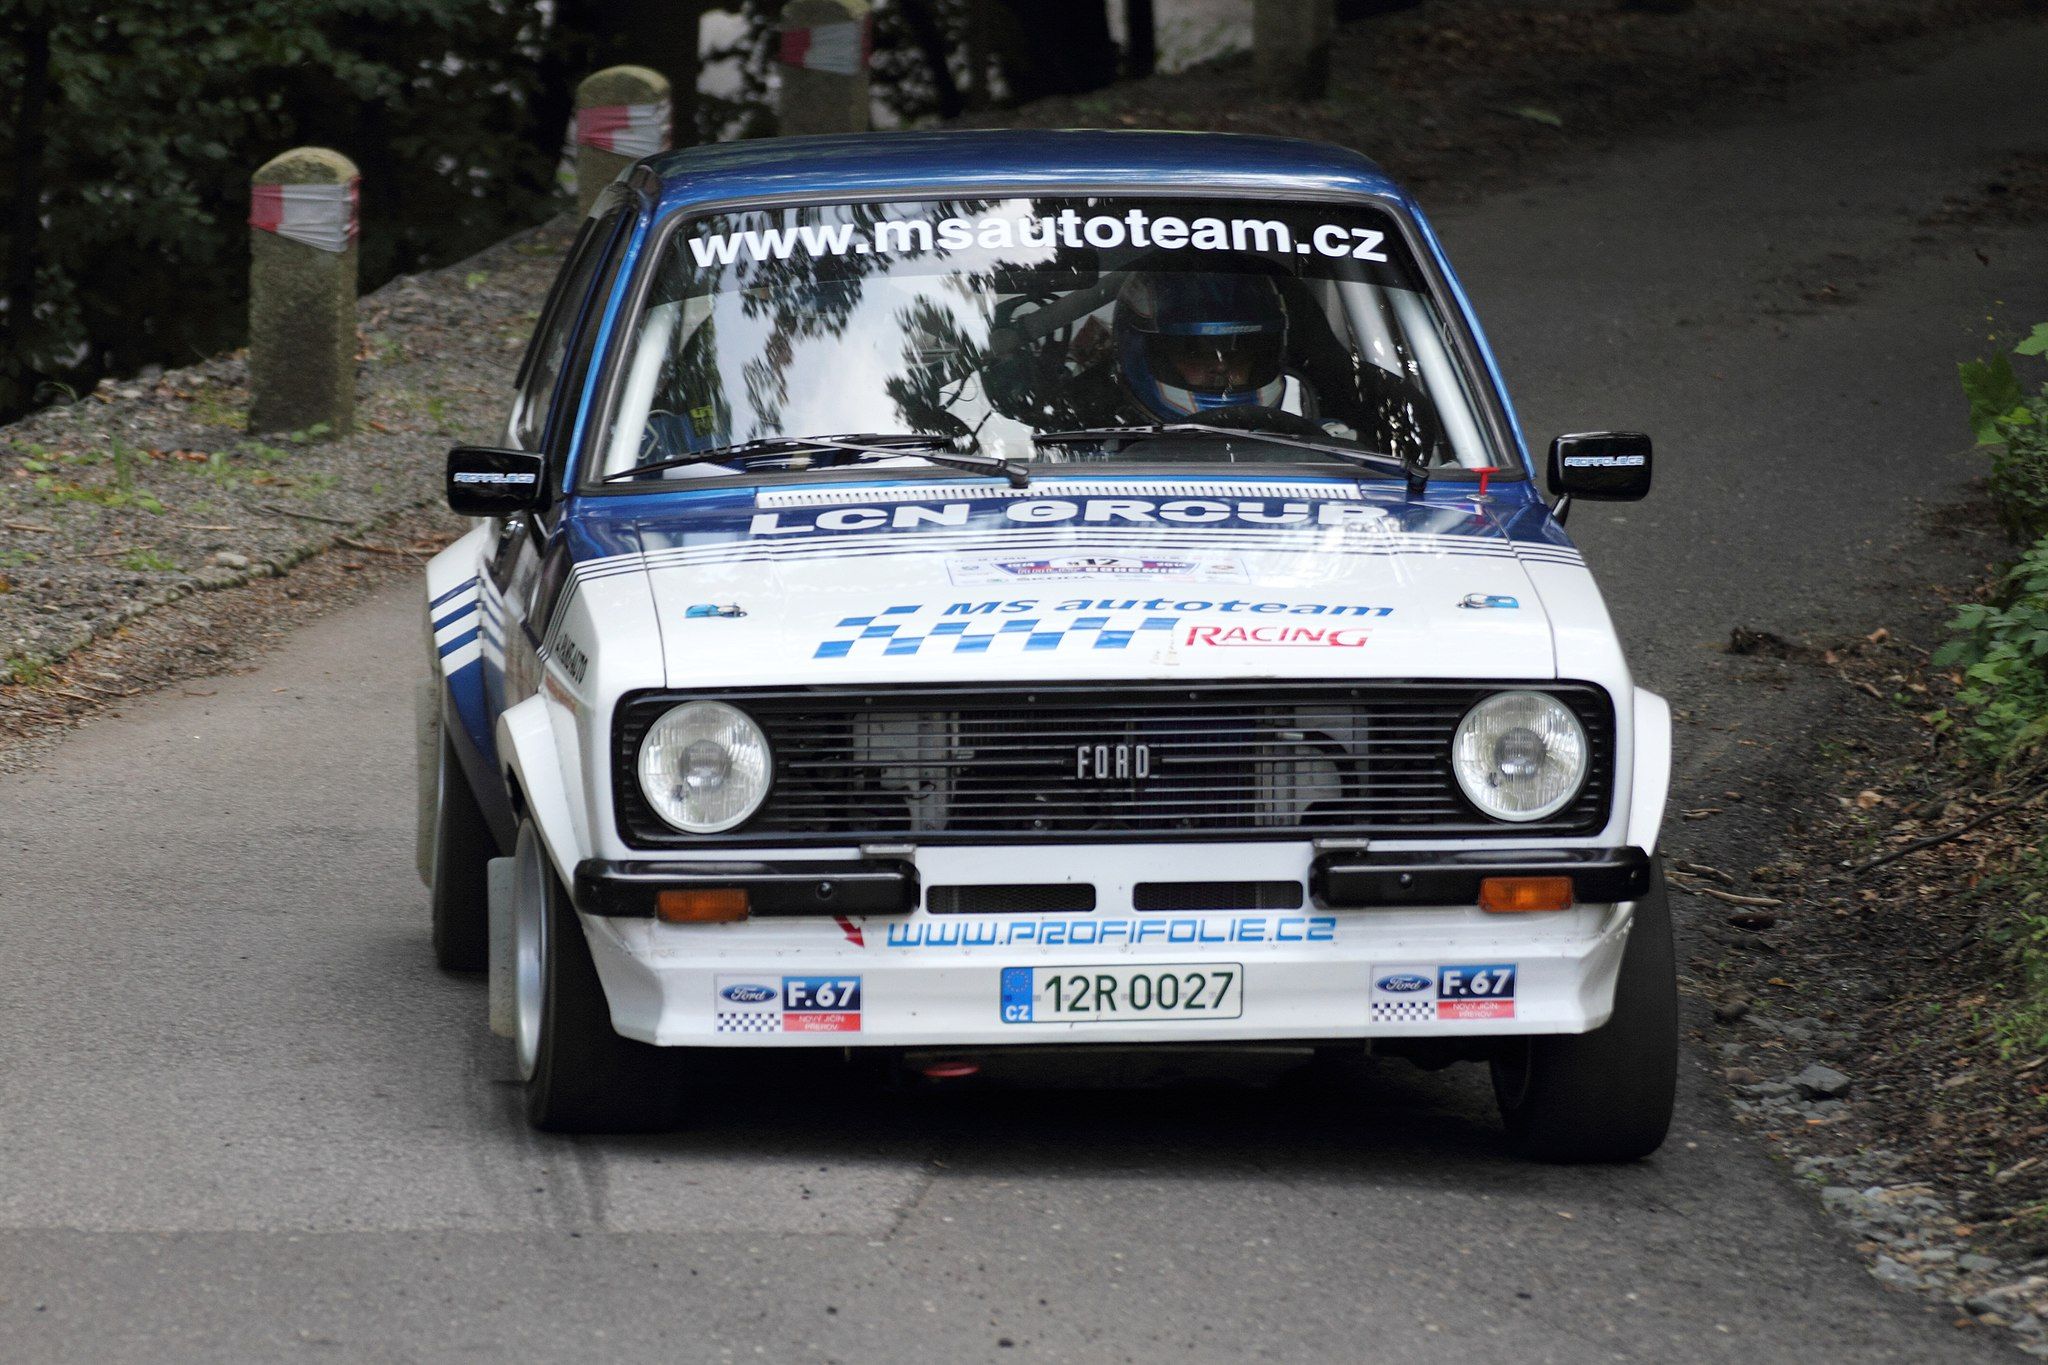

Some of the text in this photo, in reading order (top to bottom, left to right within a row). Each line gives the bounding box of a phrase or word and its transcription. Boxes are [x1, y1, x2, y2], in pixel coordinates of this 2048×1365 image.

[688, 208, 1388, 267] www.msautoteam.cz
[749, 500, 1389, 535] LCN GROUP
[941, 597, 1396, 617] MS autoteam
[1184, 625, 1373, 648] RACING
[1077, 743, 1150, 779] FORD
[887, 916, 1337, 947] WWW.PROFIFOLIE.CZ
[730, 986, 767, 1001] Ford
[786, 980, 857, 1008] F.67
[1044, 971, 1235, 1013] 12R 0027
[1385, 976, 1421, 991] Ford
[1442, 969, 1512, 996] F.67
[1005, 1005, 1029, 1021] CZ
